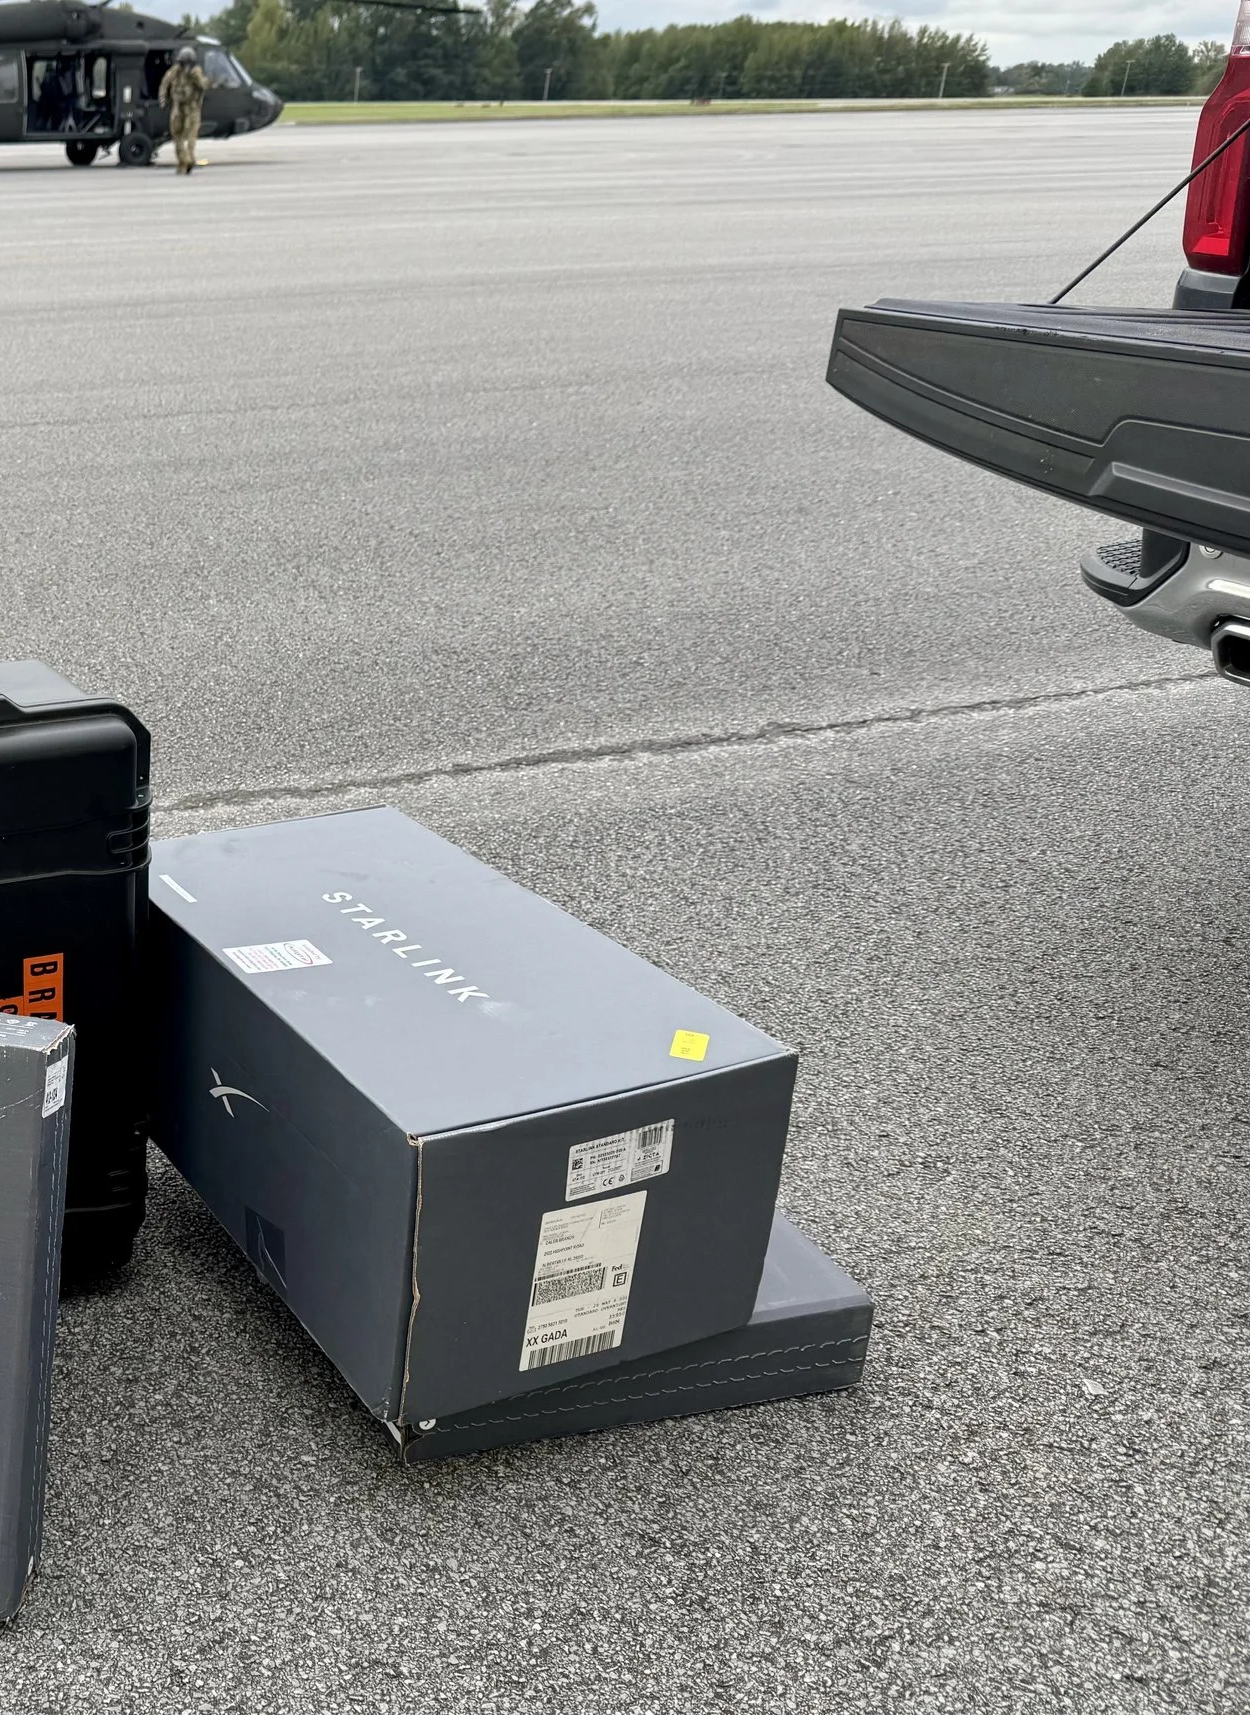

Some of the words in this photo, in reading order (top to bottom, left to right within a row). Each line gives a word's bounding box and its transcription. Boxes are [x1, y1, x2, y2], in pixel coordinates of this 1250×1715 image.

[321, 891, 491, 1003] STARLINK
[616, 1272, 624, 1283] E
[525, 1335, 539, 1347] XX
[540, 1327, 568, 1344] GADA
